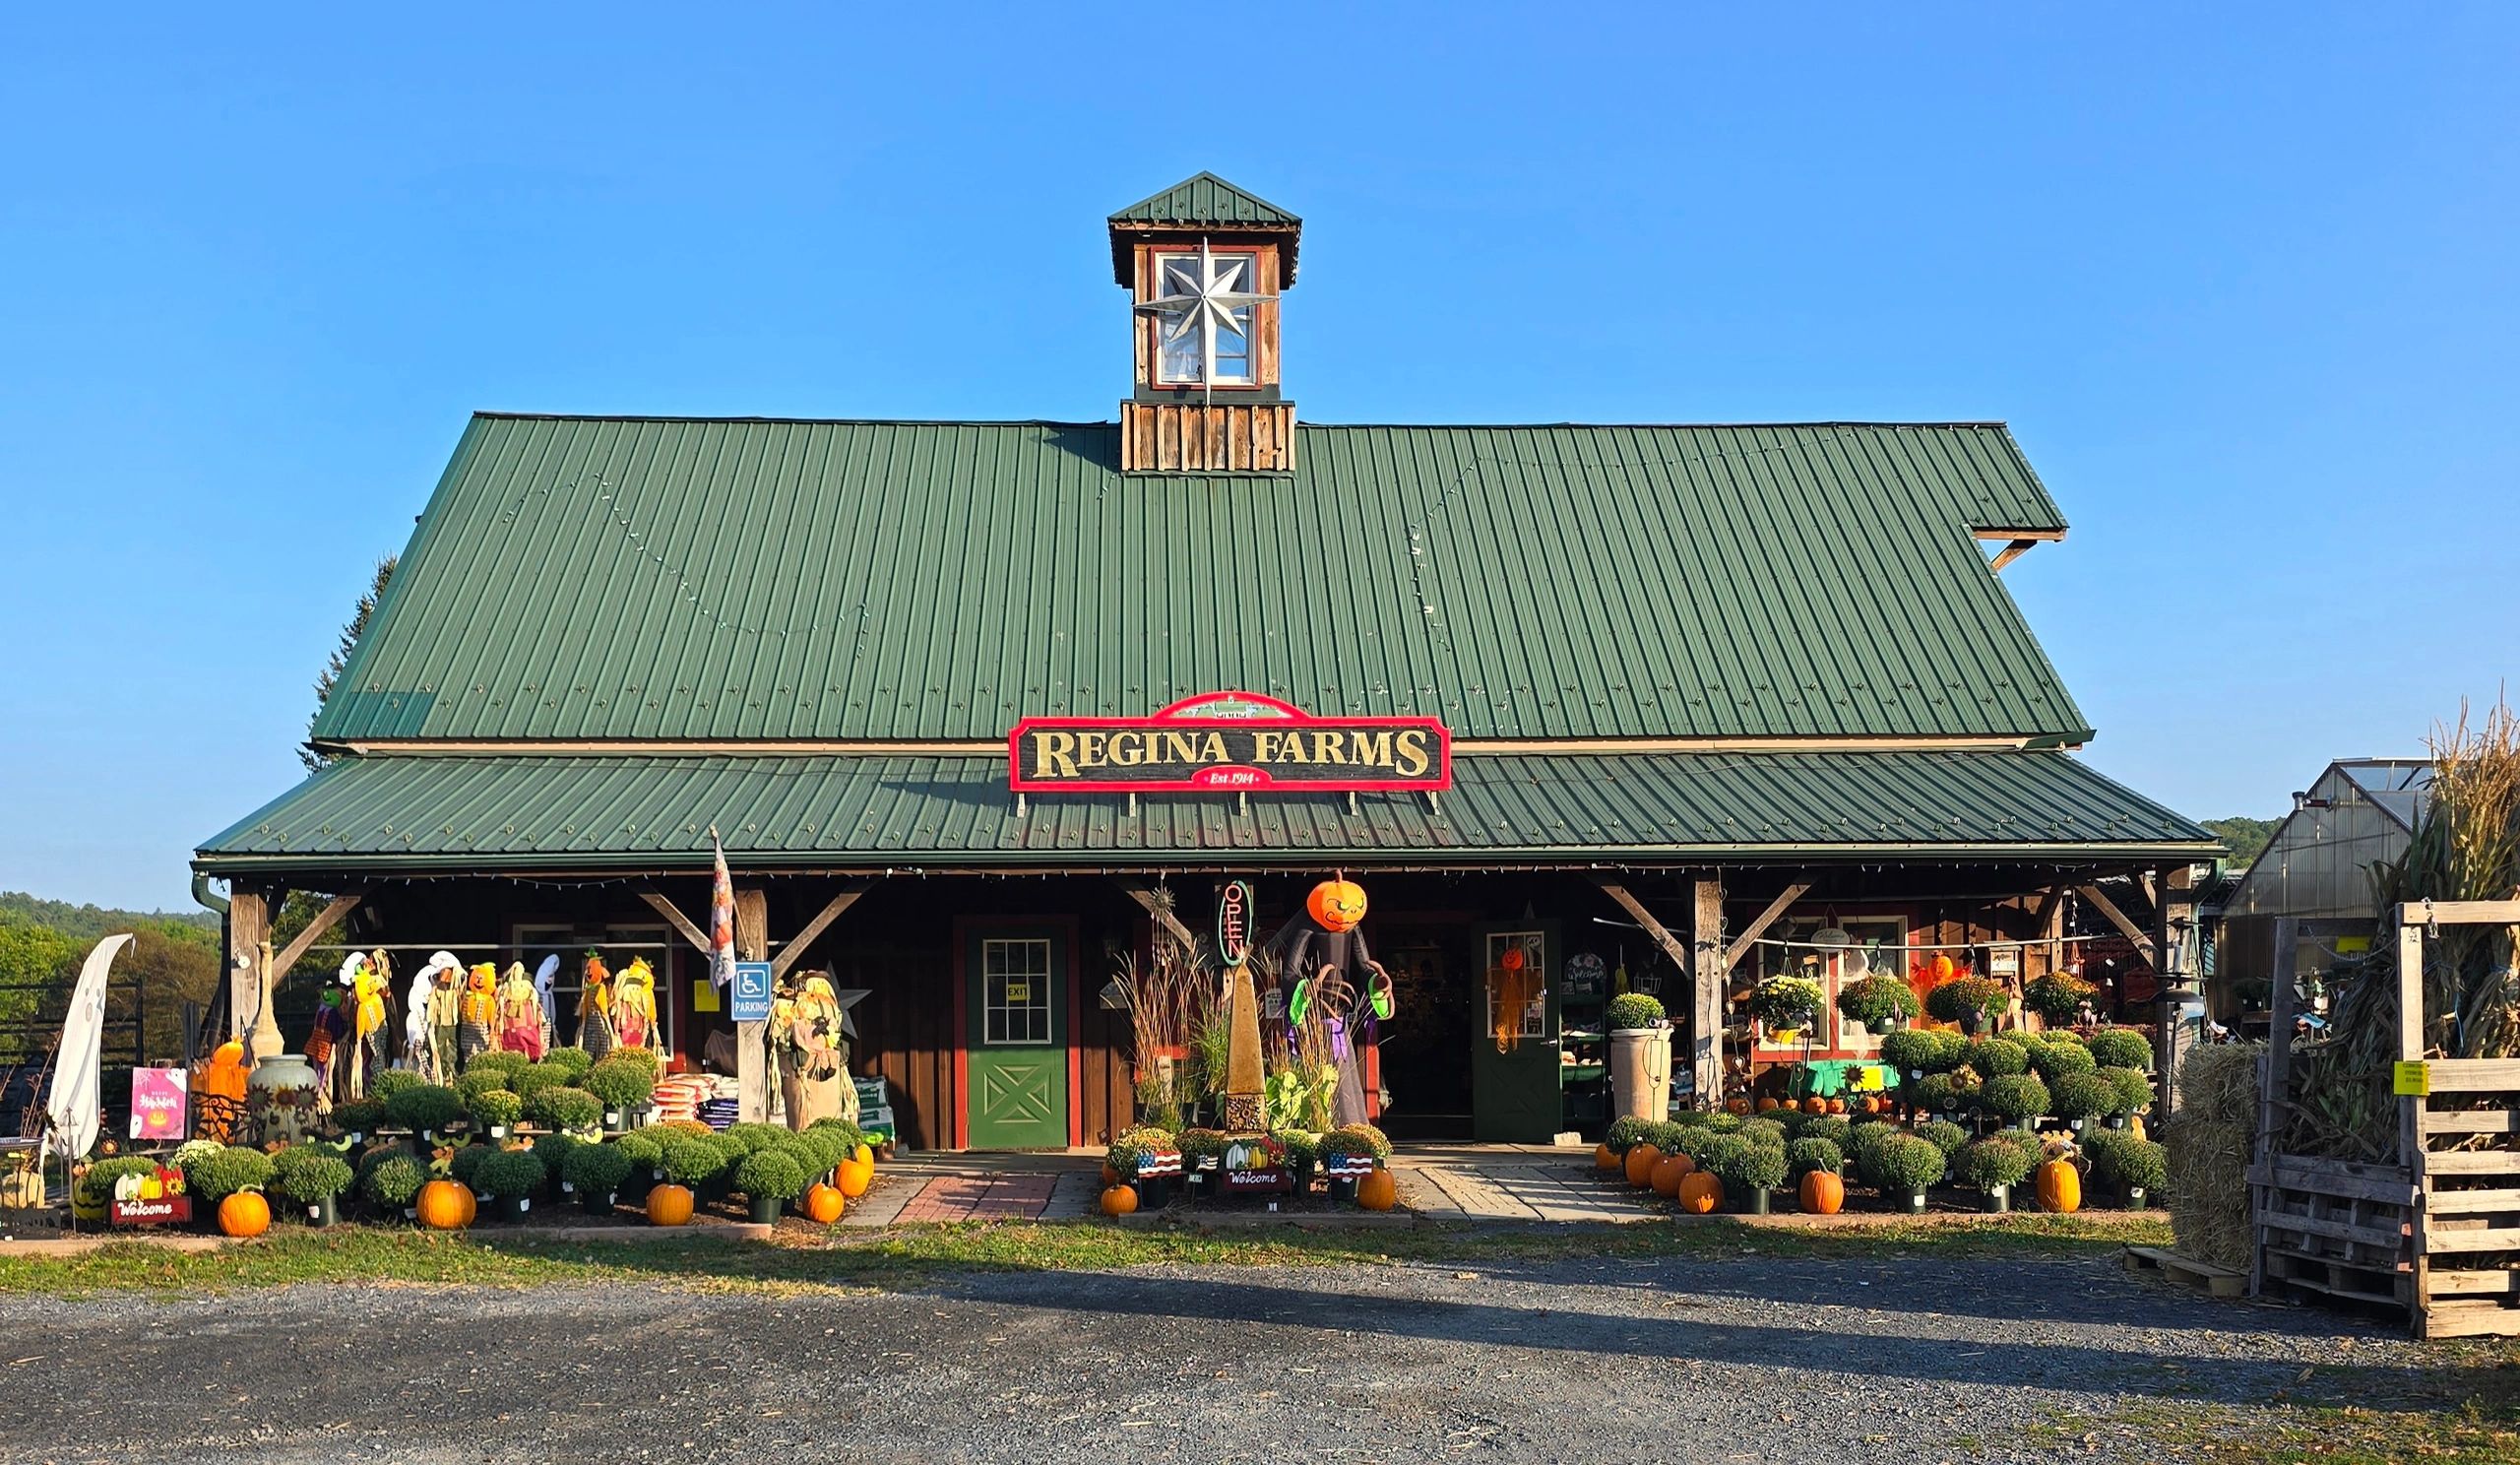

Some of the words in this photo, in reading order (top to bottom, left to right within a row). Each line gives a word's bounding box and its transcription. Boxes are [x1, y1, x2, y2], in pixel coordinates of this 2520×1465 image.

[1031, 732, 1233, 778] REGINA
[1251, 731, 1429, 777] FARMS
[1231, 772, 1255, 786] 1914
[1225, 884, 1244, 962] OPEN
[1008, 987, 1028, 996] EXIT
[735, 1001, 768, 1013] PARKING
[1228, 1171, 1278, 1184] Welcome
[117, 1200, 172, 1216] Welcome
